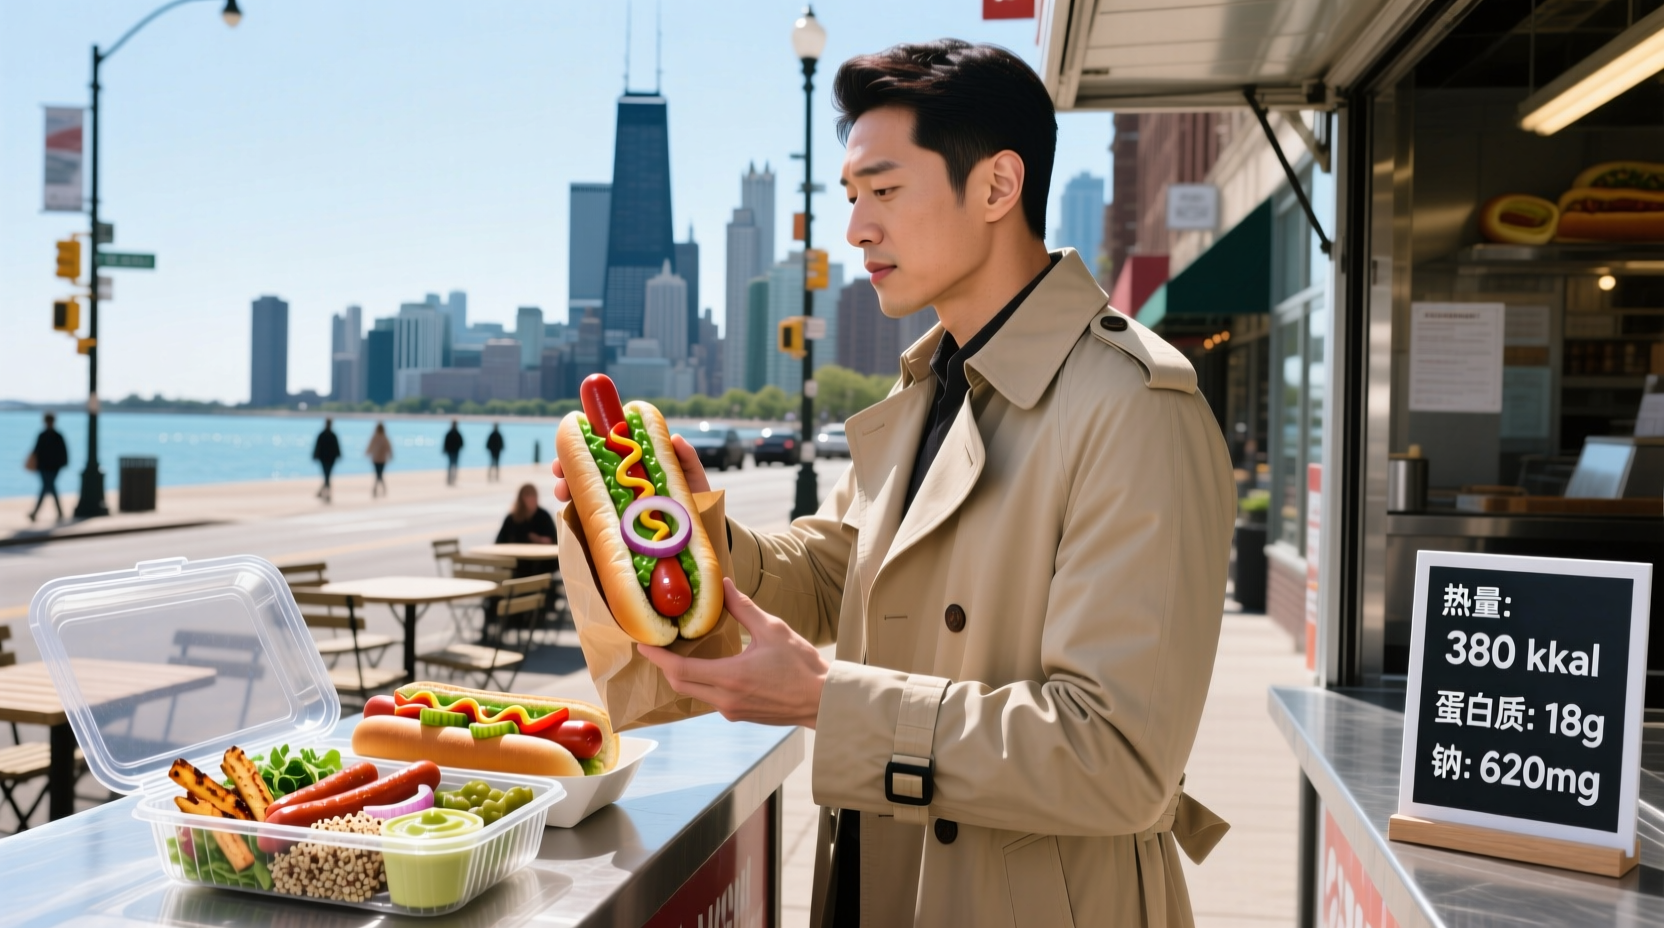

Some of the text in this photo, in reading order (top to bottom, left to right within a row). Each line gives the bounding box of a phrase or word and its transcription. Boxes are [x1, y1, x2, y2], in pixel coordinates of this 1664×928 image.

[1441, 583, 1512, 619] 热量:
[1445, 630, 1600, 678] 380 kkal
[1434, 690, 1605, 749] 蛋白质: 18g
[1431, 742, 1601, 807] 钠: 620mg
